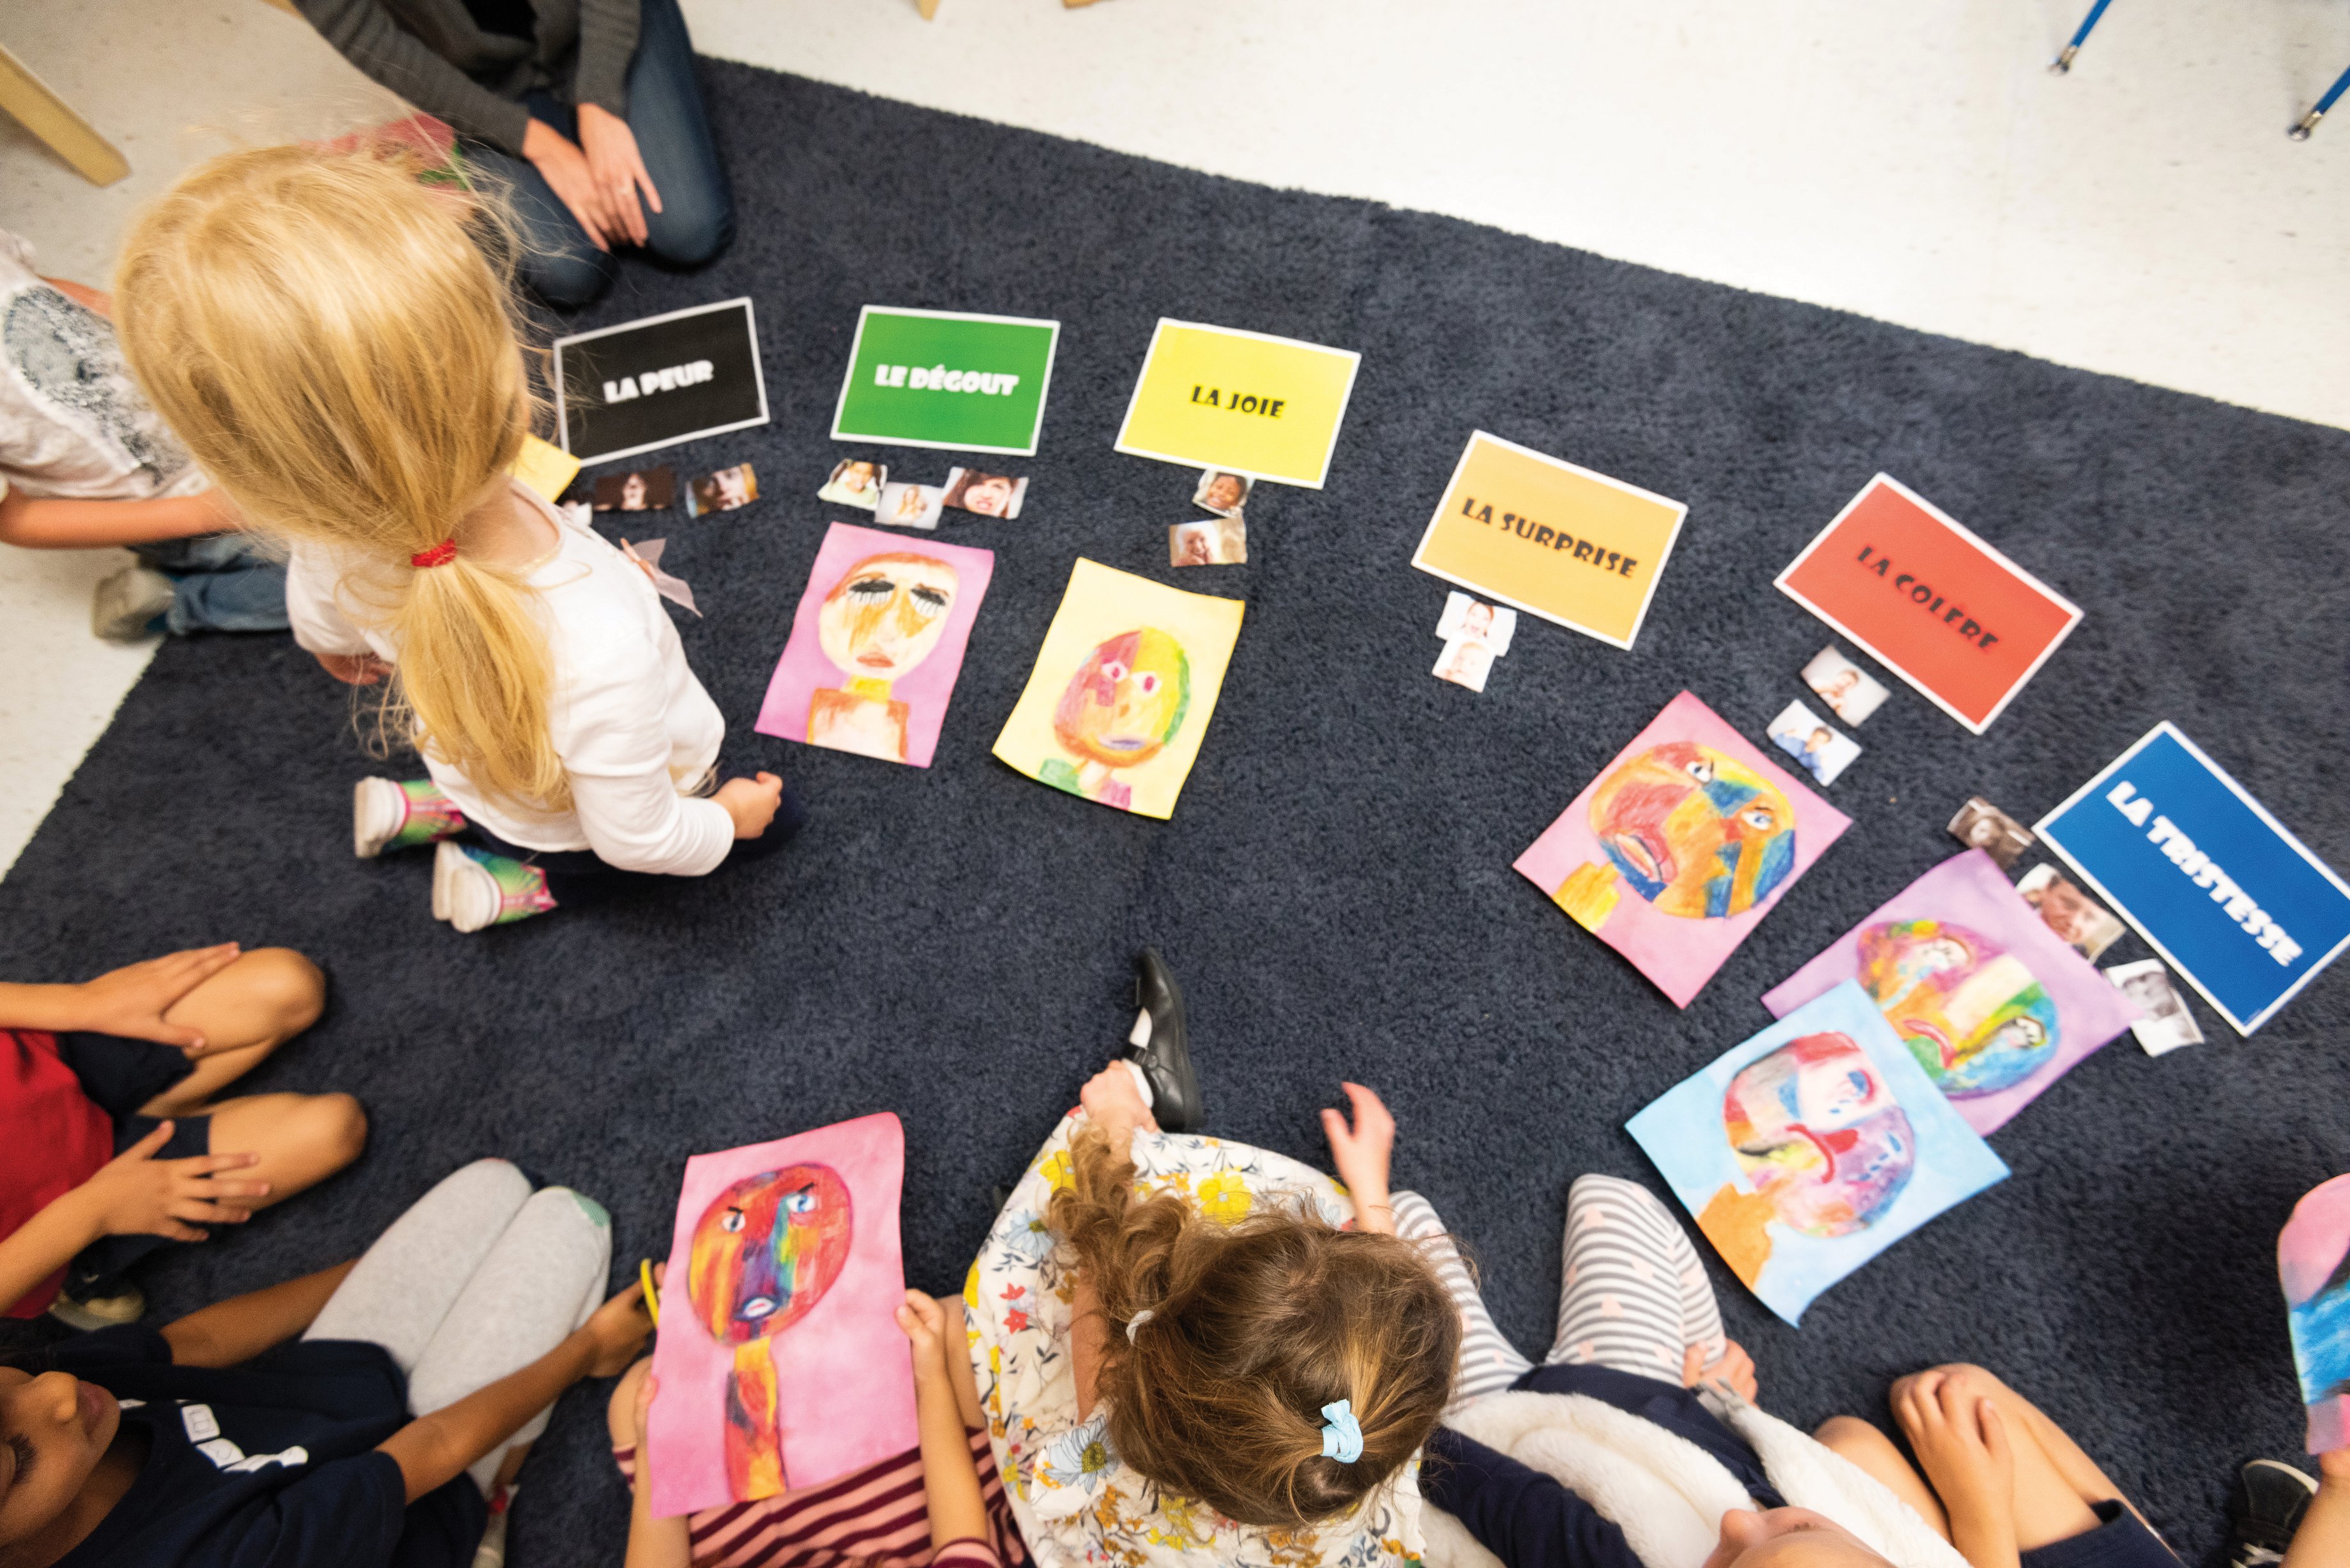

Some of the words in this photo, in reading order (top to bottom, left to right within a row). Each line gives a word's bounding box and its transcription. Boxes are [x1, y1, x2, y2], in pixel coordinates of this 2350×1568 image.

[603, 377, 639, 404] LA
[639, 359, 714, 396] PEUR
[875, 364, 908, 388] LE
[909, 363, 1019, 396] DÉGOUT
[1192, 386, 1218, 406] LA
[1227, 393, 1285, 418] JOIE
[1462, 497, 1492, 524] LA
[1501, 513, 1637, 578] SURPRISE
[1857, 547, 1890, 577] LA
[2106, 780, 2155, 827] LA
[2146, 815, 2303, 967] TRISTESSE
